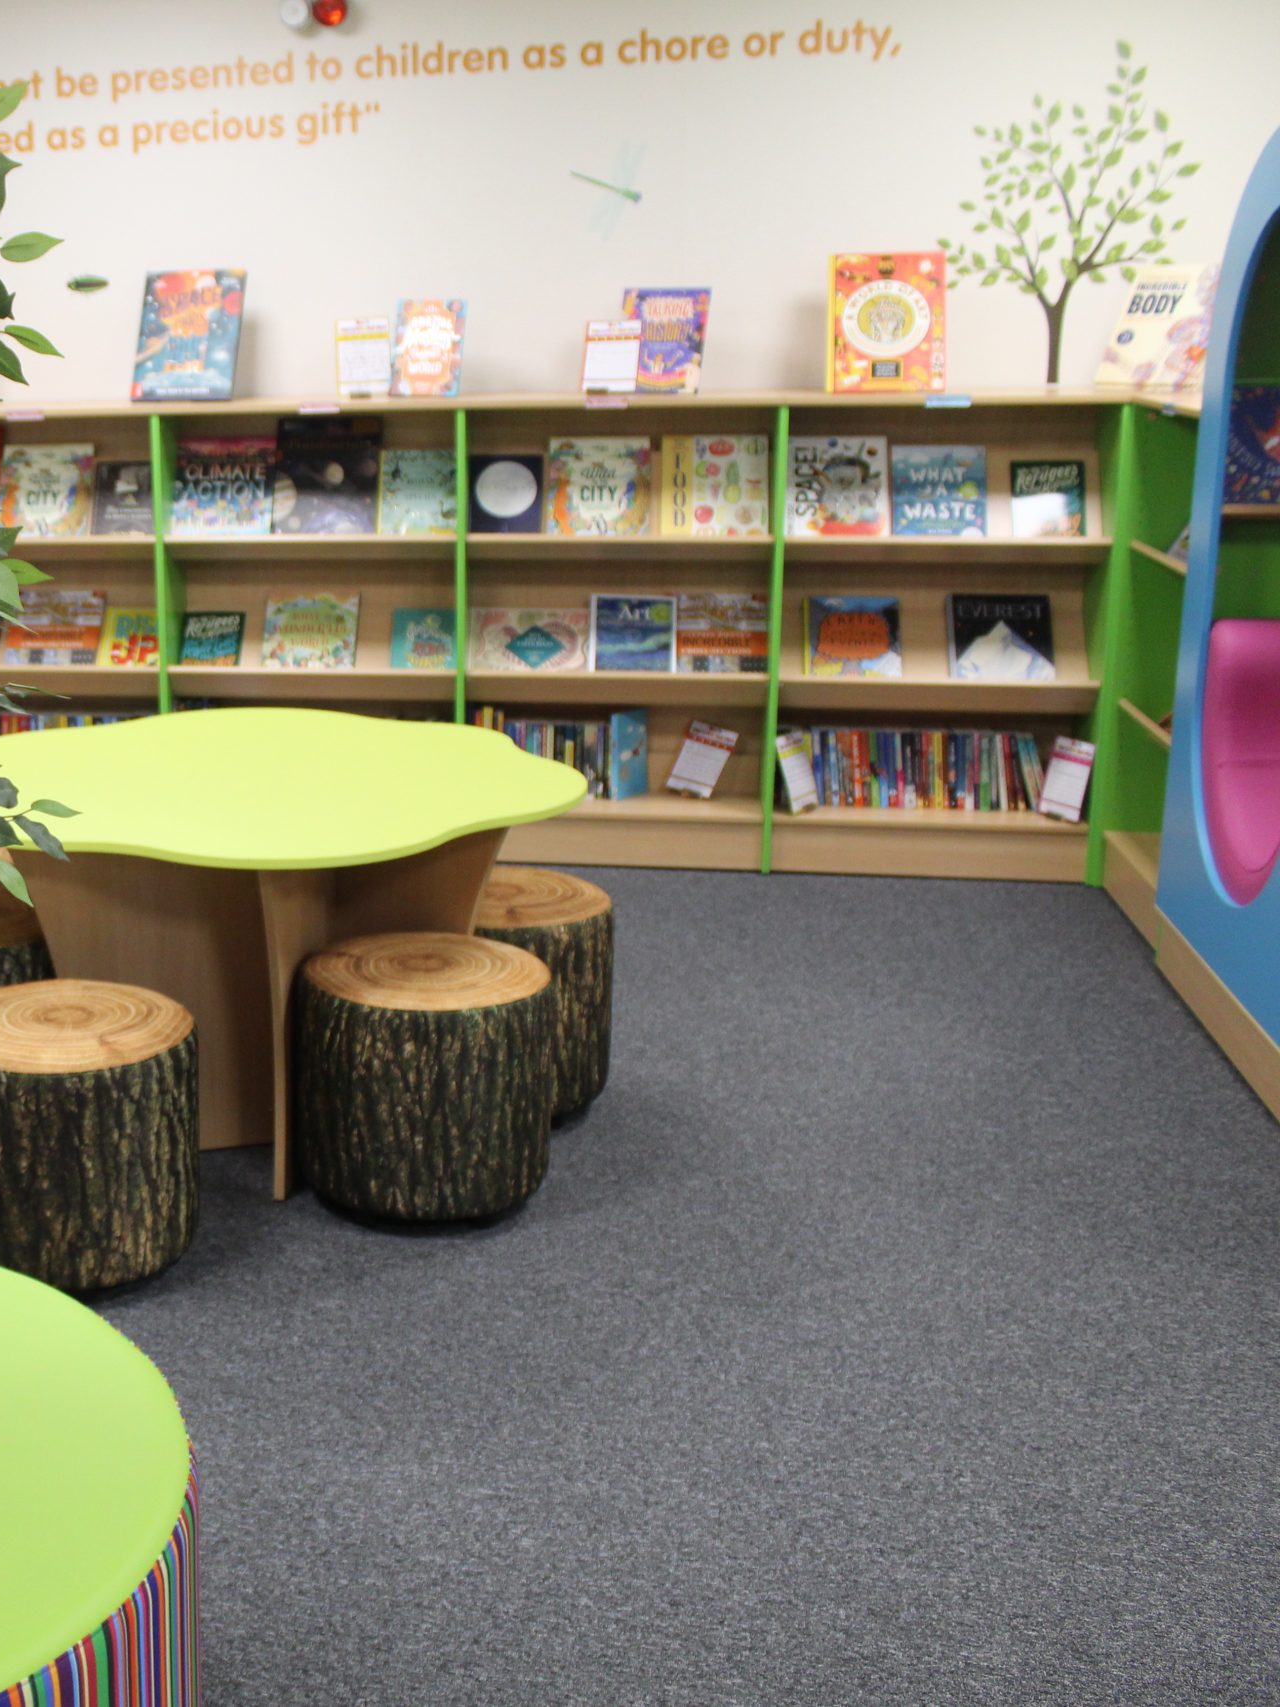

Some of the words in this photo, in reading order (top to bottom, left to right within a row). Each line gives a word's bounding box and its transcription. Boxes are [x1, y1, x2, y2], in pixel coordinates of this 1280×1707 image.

[55, 67, 99, 99] be
[111, 50, 294, 104] presented
[306, 52, 343, 82] to
[354, 41, 510, 80] children
[522, 42, 567, 71] as
[579, 41, 605, 68] a
[617, 29, 731, 65] chore
[743, 30, 785, 59] or
[798, 18, 902, 62] duty,
[47, 127, 86, 152] as
[98, 124, 120, 149] a
[131, 110, 285, 154] precious
[1127, 294, 1183, 314] BODY
[185, 463, 267, 481] CLIMATE
[910, 466, 968, 483] WHAT
[26, 489, 60, 506] CITY
[181, 480, 266, 500] ACTION
[579, 484, 618, 503] CITY
[935, 483, 948, 497] A
[903, 501, 976, 520] WASTE
[957, 603, 1042, 620] EVEREST
